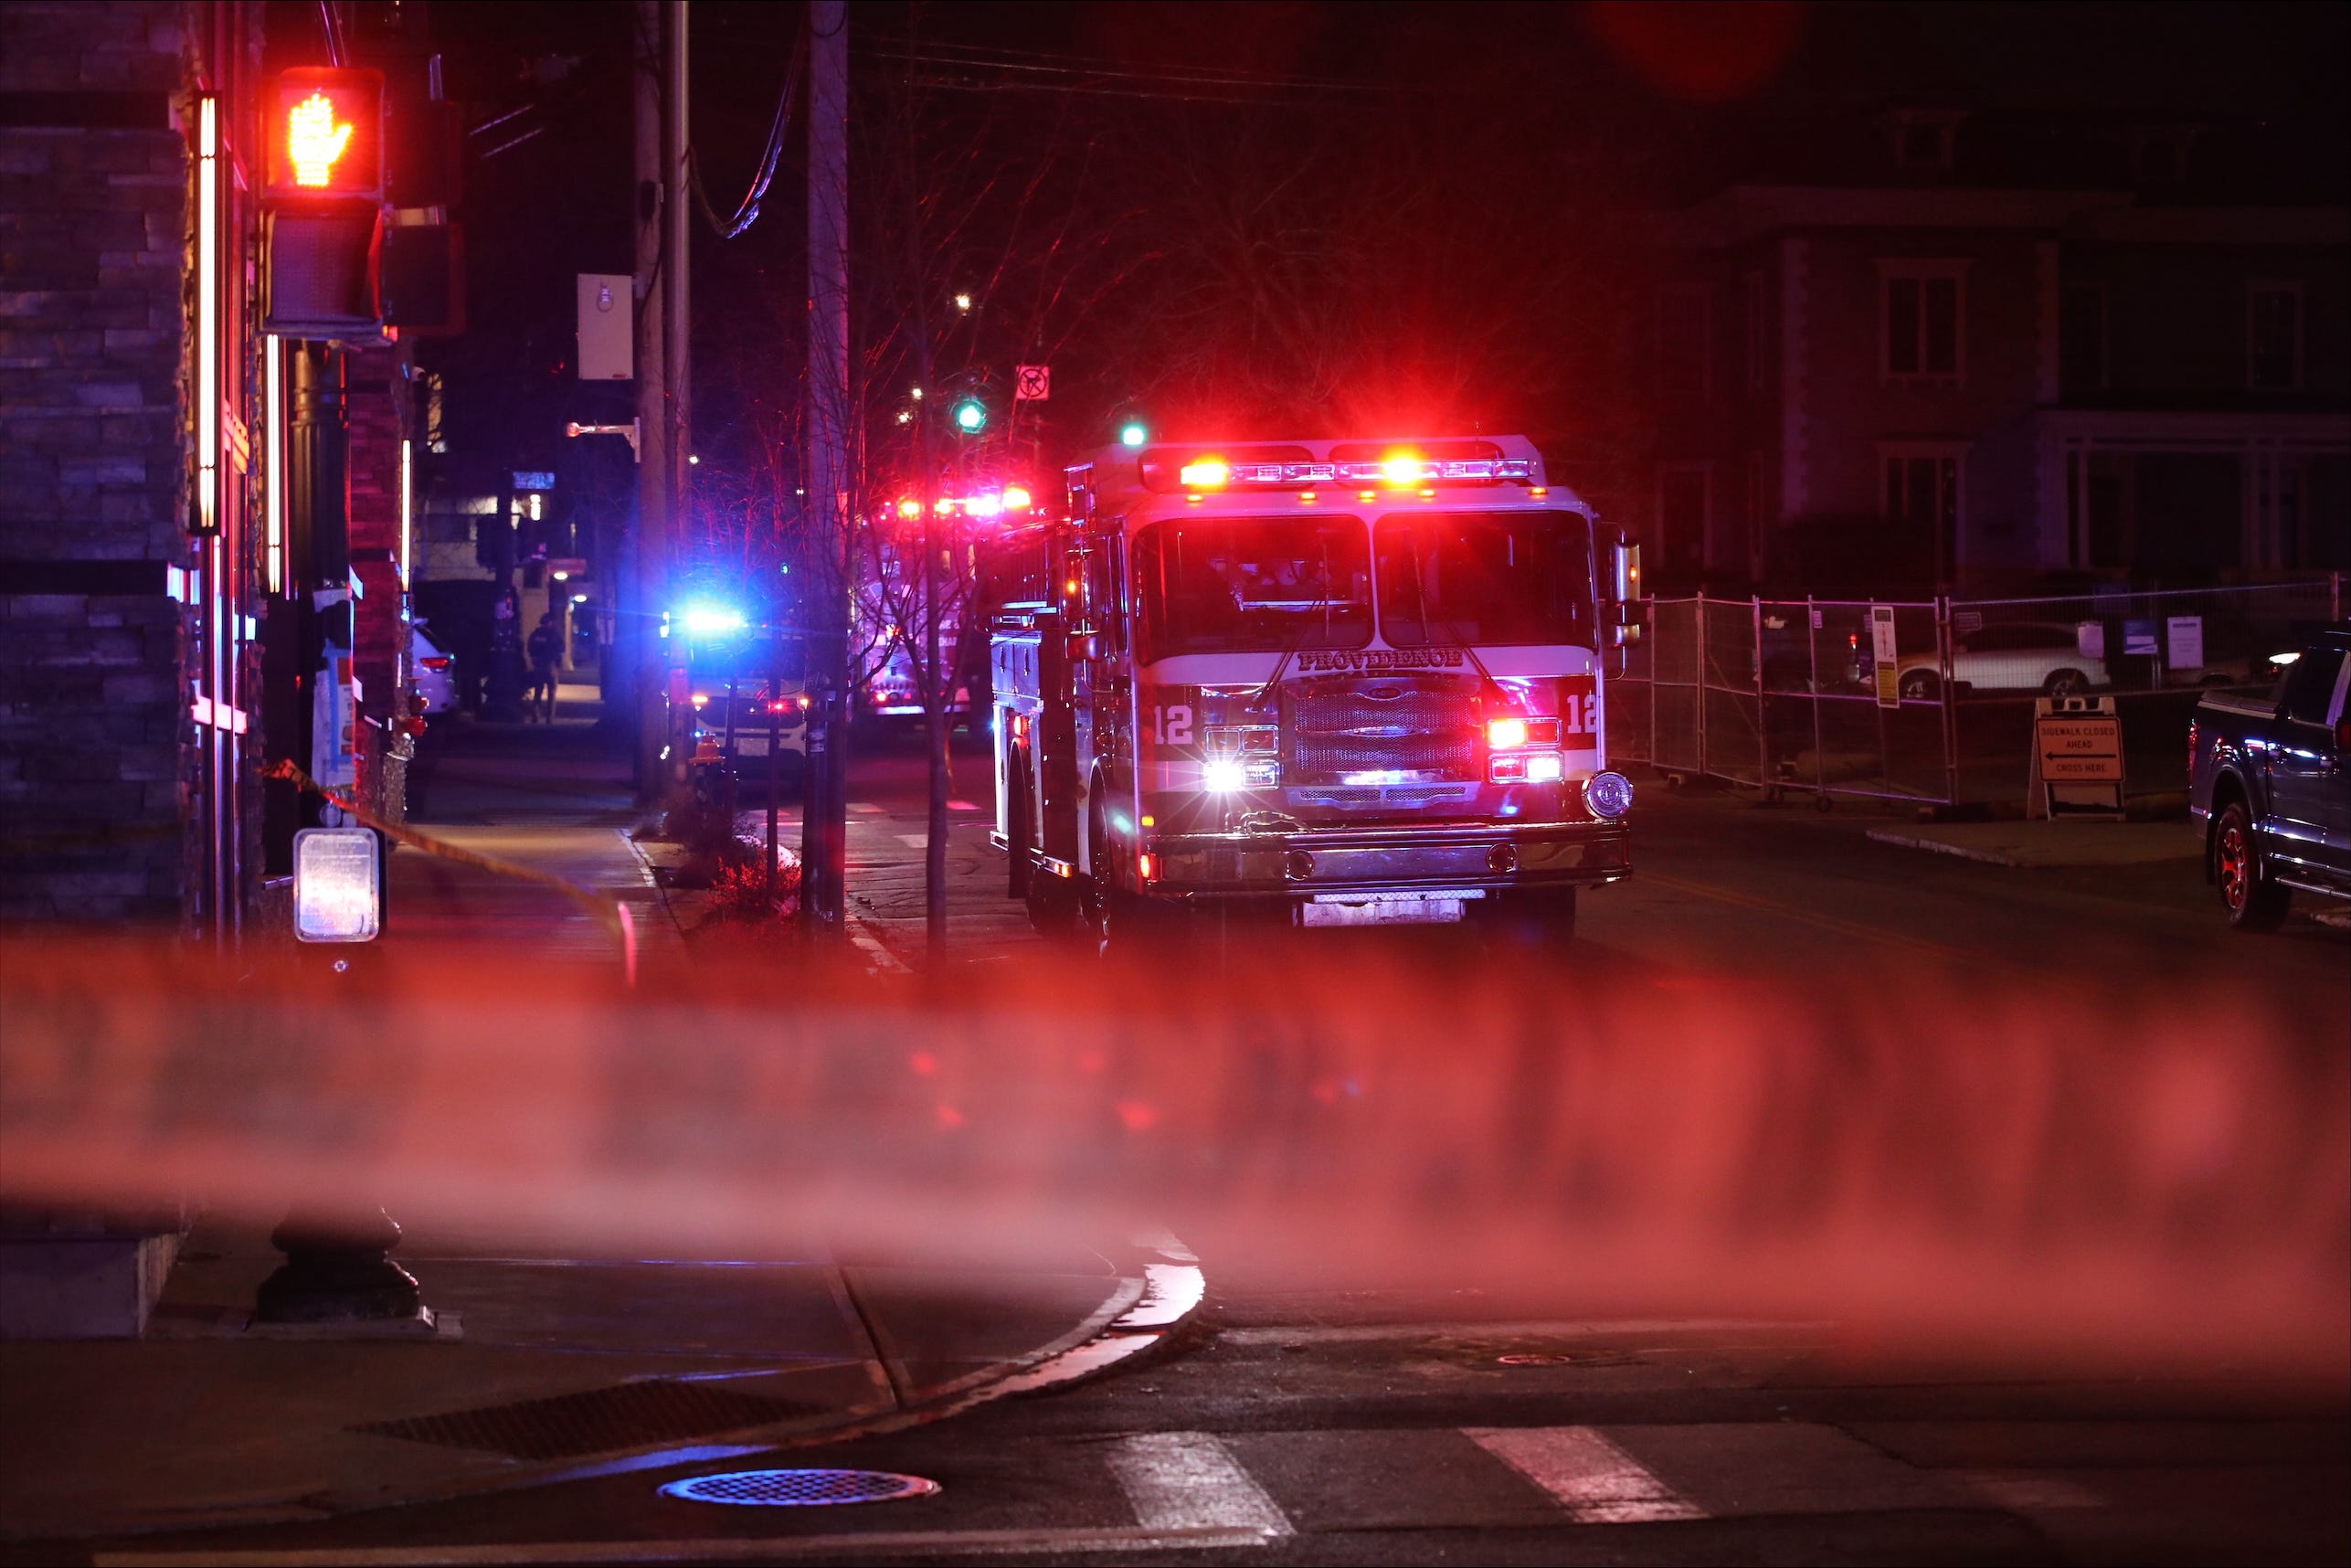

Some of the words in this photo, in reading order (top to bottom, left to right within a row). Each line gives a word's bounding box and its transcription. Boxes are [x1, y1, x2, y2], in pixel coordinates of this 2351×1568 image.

[1297, 649, 1464, 672] PROVIDENCE
[1566, 694, 1597, 734] 12
[1154, 705, 1193, 745] 12
[2041, 727, 2081, 736] SIDEWALK
[2083, 727, 2114, 736] CLOSED
[2067, 740, 2092, 748] AHEAD
[2056, 764, 2083, 772] CROSS
[2085, 764, 2106, 772] HERE
